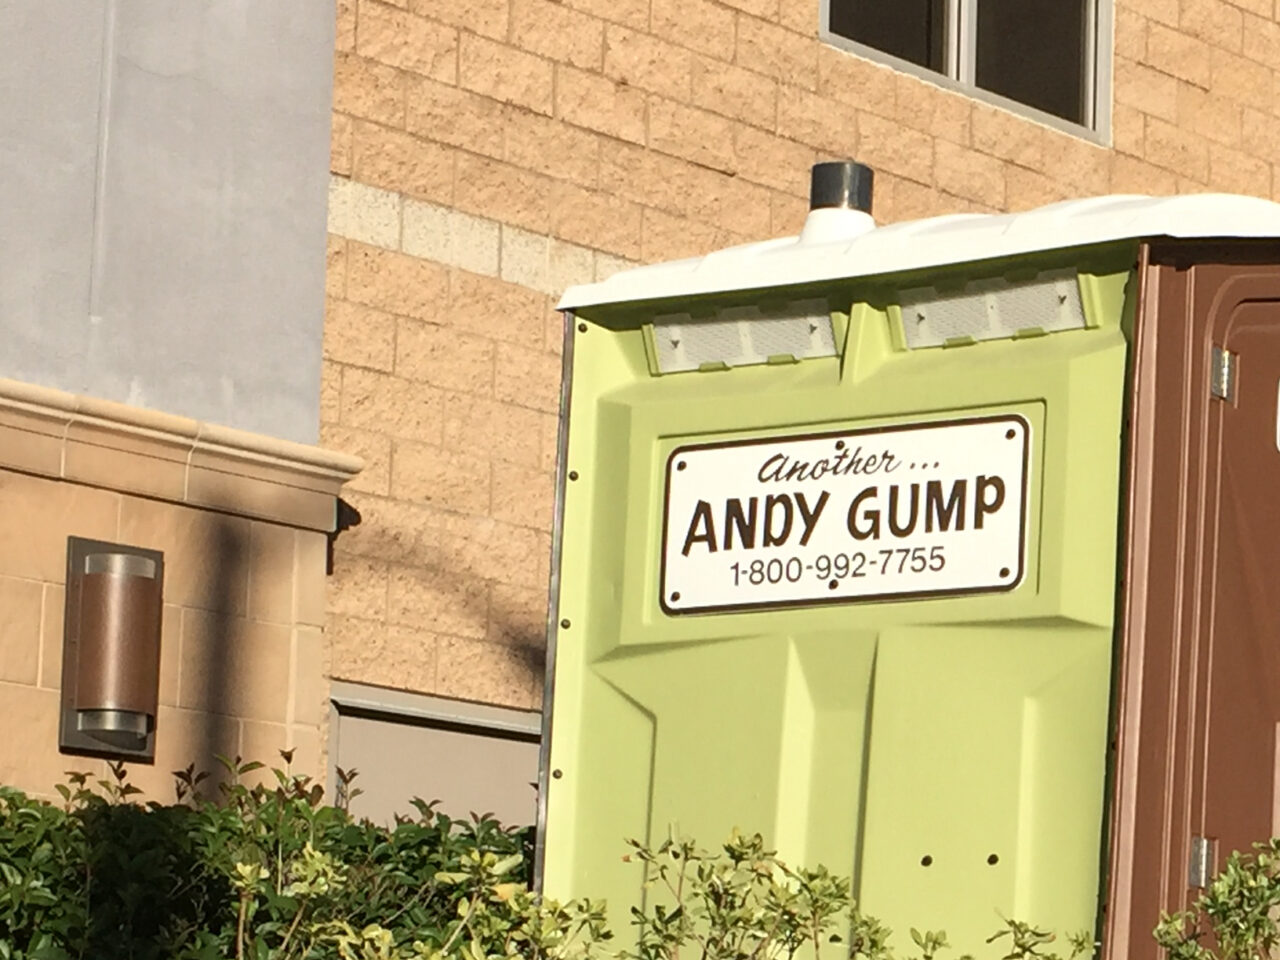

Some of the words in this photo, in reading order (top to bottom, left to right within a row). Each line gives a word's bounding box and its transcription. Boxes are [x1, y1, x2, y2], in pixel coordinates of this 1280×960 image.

[681, 489, 831, 557] ANDY
[846, 474, 1006, 541] GUMP
[729, 546, 946, 587] 1-800-992-7755
